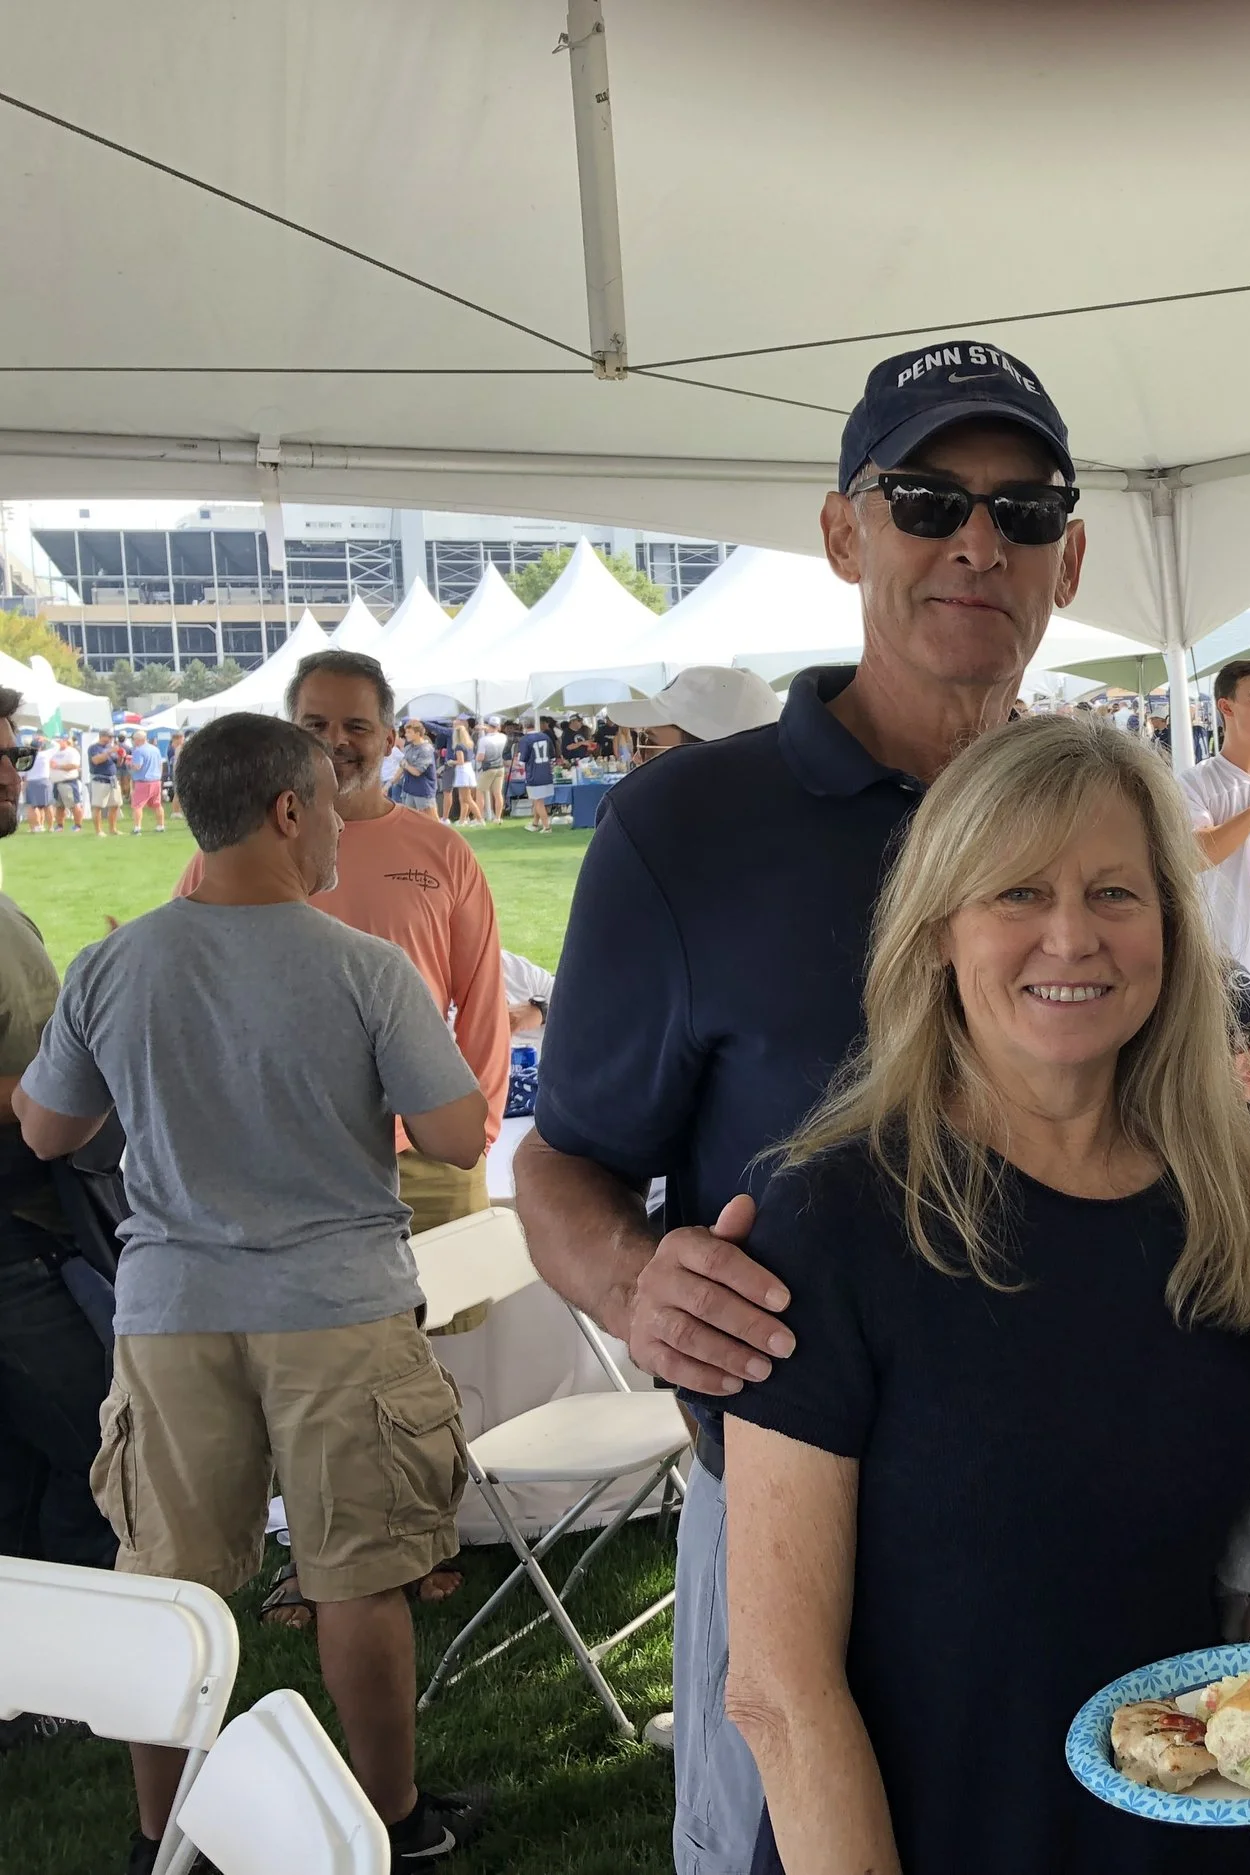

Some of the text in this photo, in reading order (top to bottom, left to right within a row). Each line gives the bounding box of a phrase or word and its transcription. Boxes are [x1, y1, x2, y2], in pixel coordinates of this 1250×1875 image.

[897, 345, 1041, 396] PENN STATE
[533, 740, 549, 764] 17
